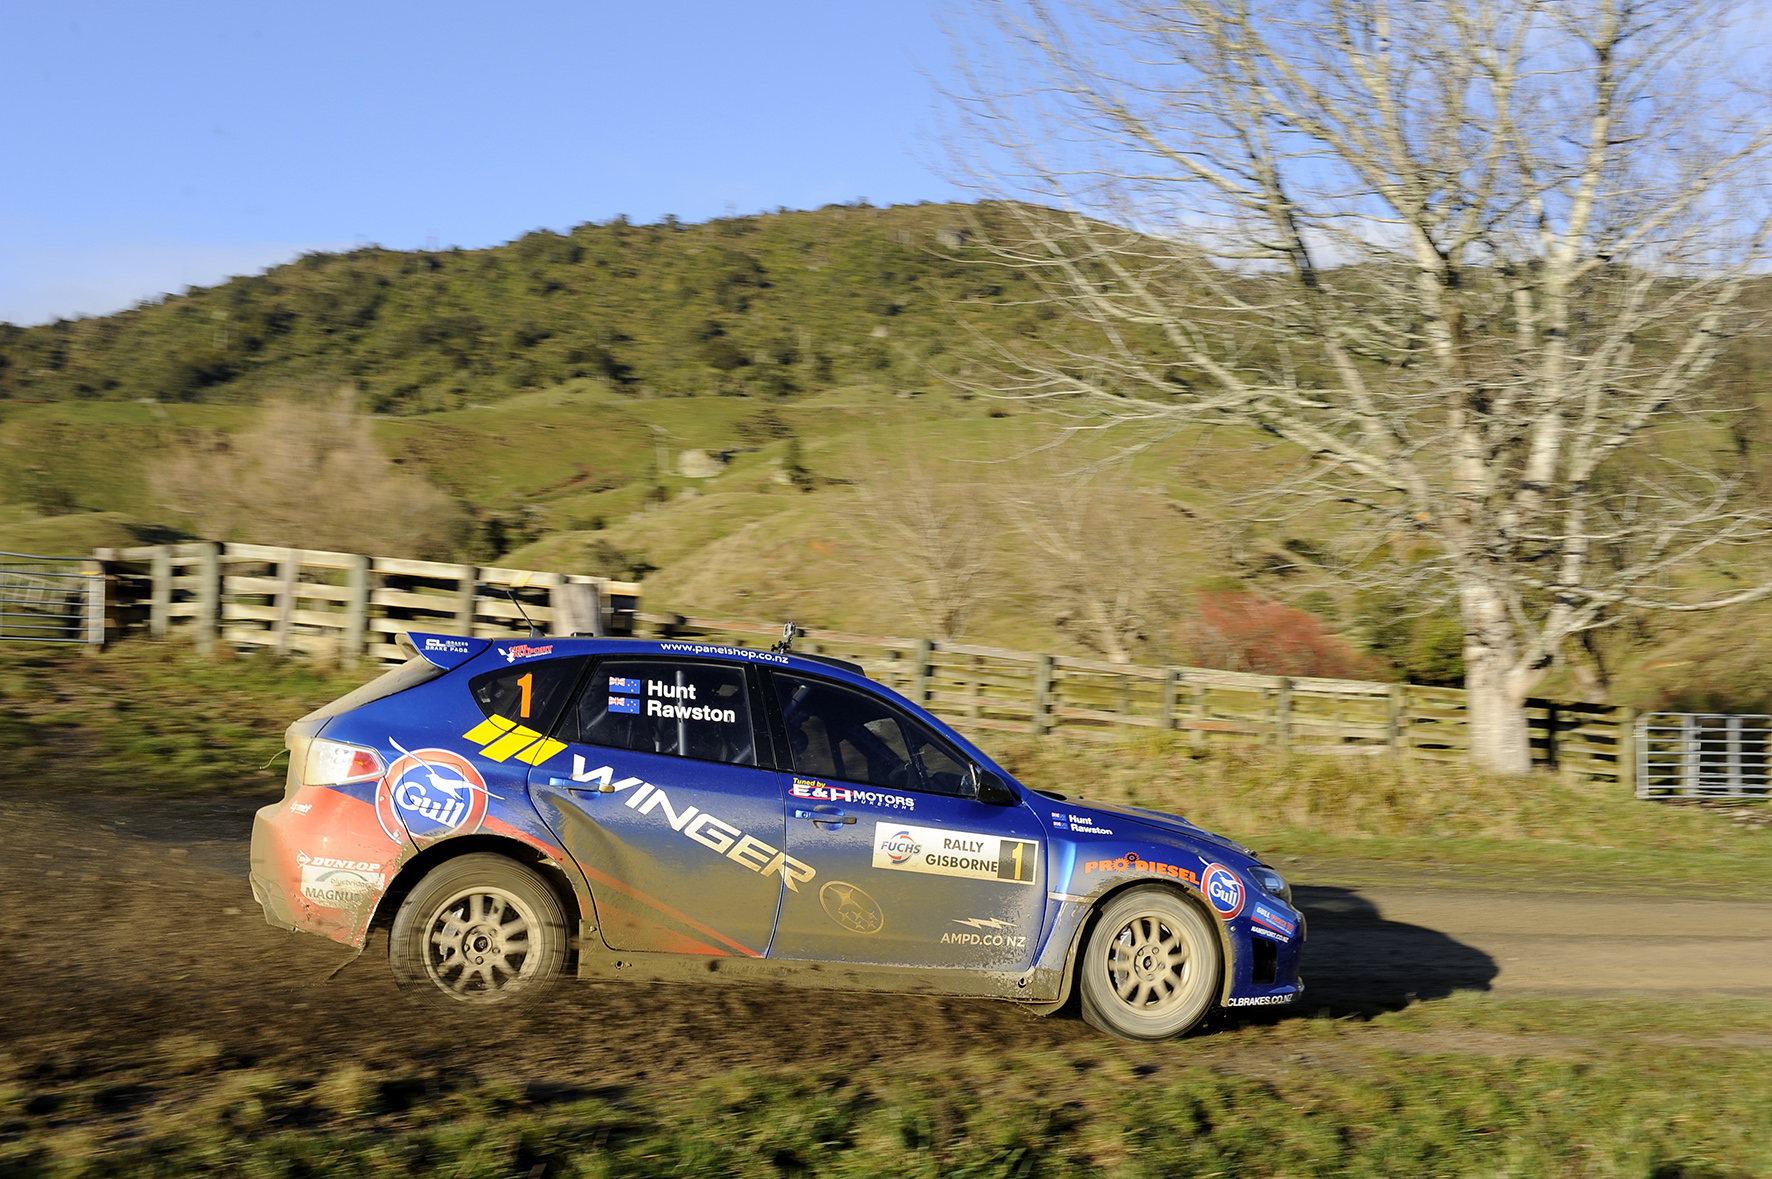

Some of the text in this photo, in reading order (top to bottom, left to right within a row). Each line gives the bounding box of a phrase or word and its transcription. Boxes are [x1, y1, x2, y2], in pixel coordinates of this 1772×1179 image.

[660, 643, 789, 664] www.panelshop.co.nz
[517, 672, 533, 719] 1
[647, 680, 696, 700] Hunt
[647, 699, 736, 723] Rawston
[793, 777, 826, 788] Tuned by
[395, 781, 465, 828] Gull
[853, 790, 915, 807] MOTORS
[573, 753, 817, 893] WINGER
[1068, 814, 1093, 825] Hunt
[1070, 823, 1113, 835] Rawston
[880, 841, 921, 854] FUCHS
[943, 838, 984, 853] RALLY
[311, 856, 381, 872] DUNLOP
[925, 854, 998, 873] GISBORNE
[1012, 842, 1024, 880] 1
[1210, 881, 1238, 907] Gull
[1227, 994, 1293, 1007] CLBRAKES.CO.NZ
